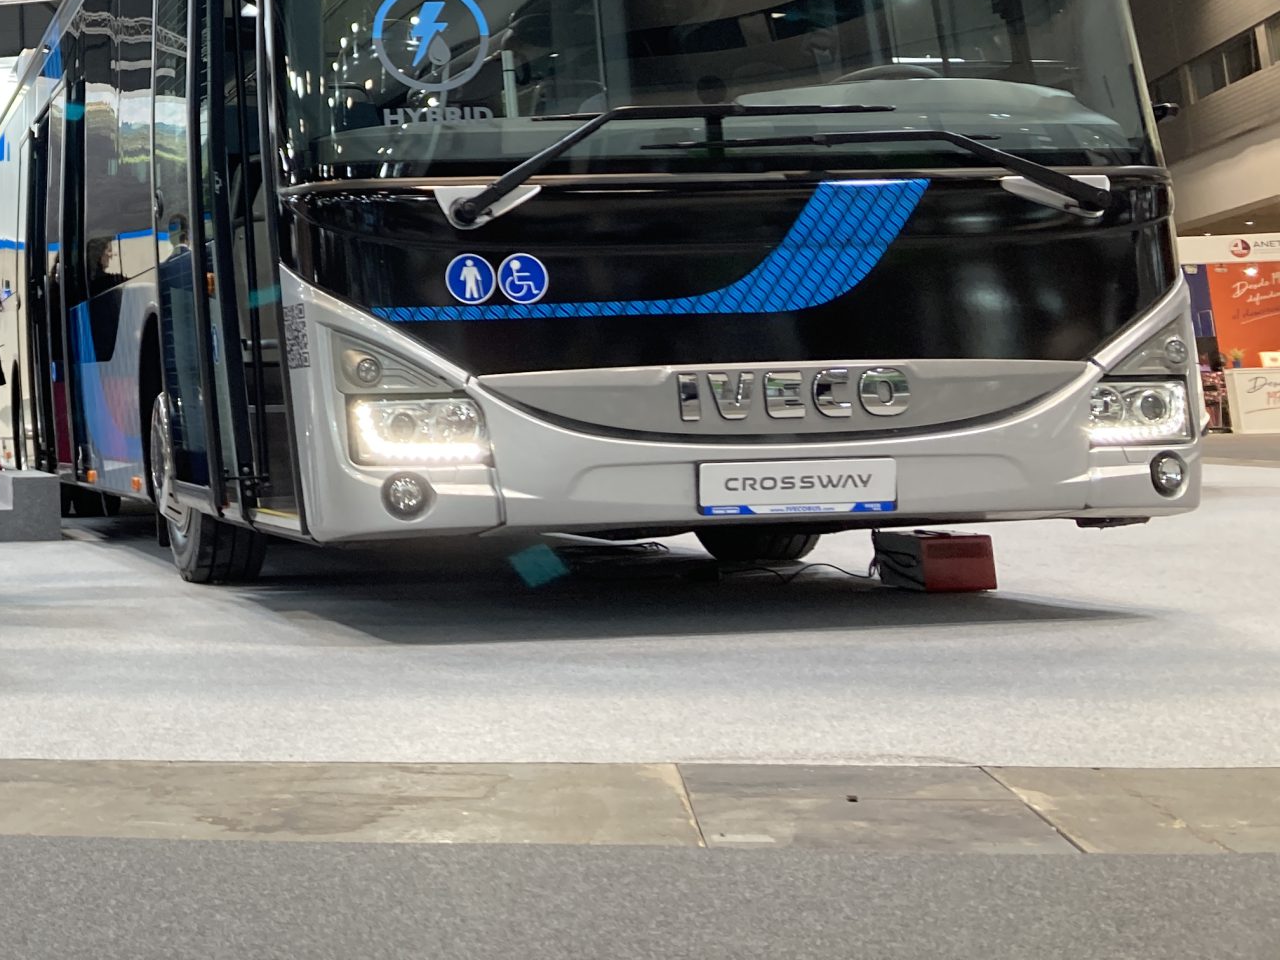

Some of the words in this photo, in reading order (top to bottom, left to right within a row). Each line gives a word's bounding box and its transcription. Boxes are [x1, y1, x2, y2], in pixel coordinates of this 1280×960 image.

[383, 106, 494, 126] HYBRID
[677, 367, 911, 422] IVECO
[724, 473, 872, 492] CROSSWAY
